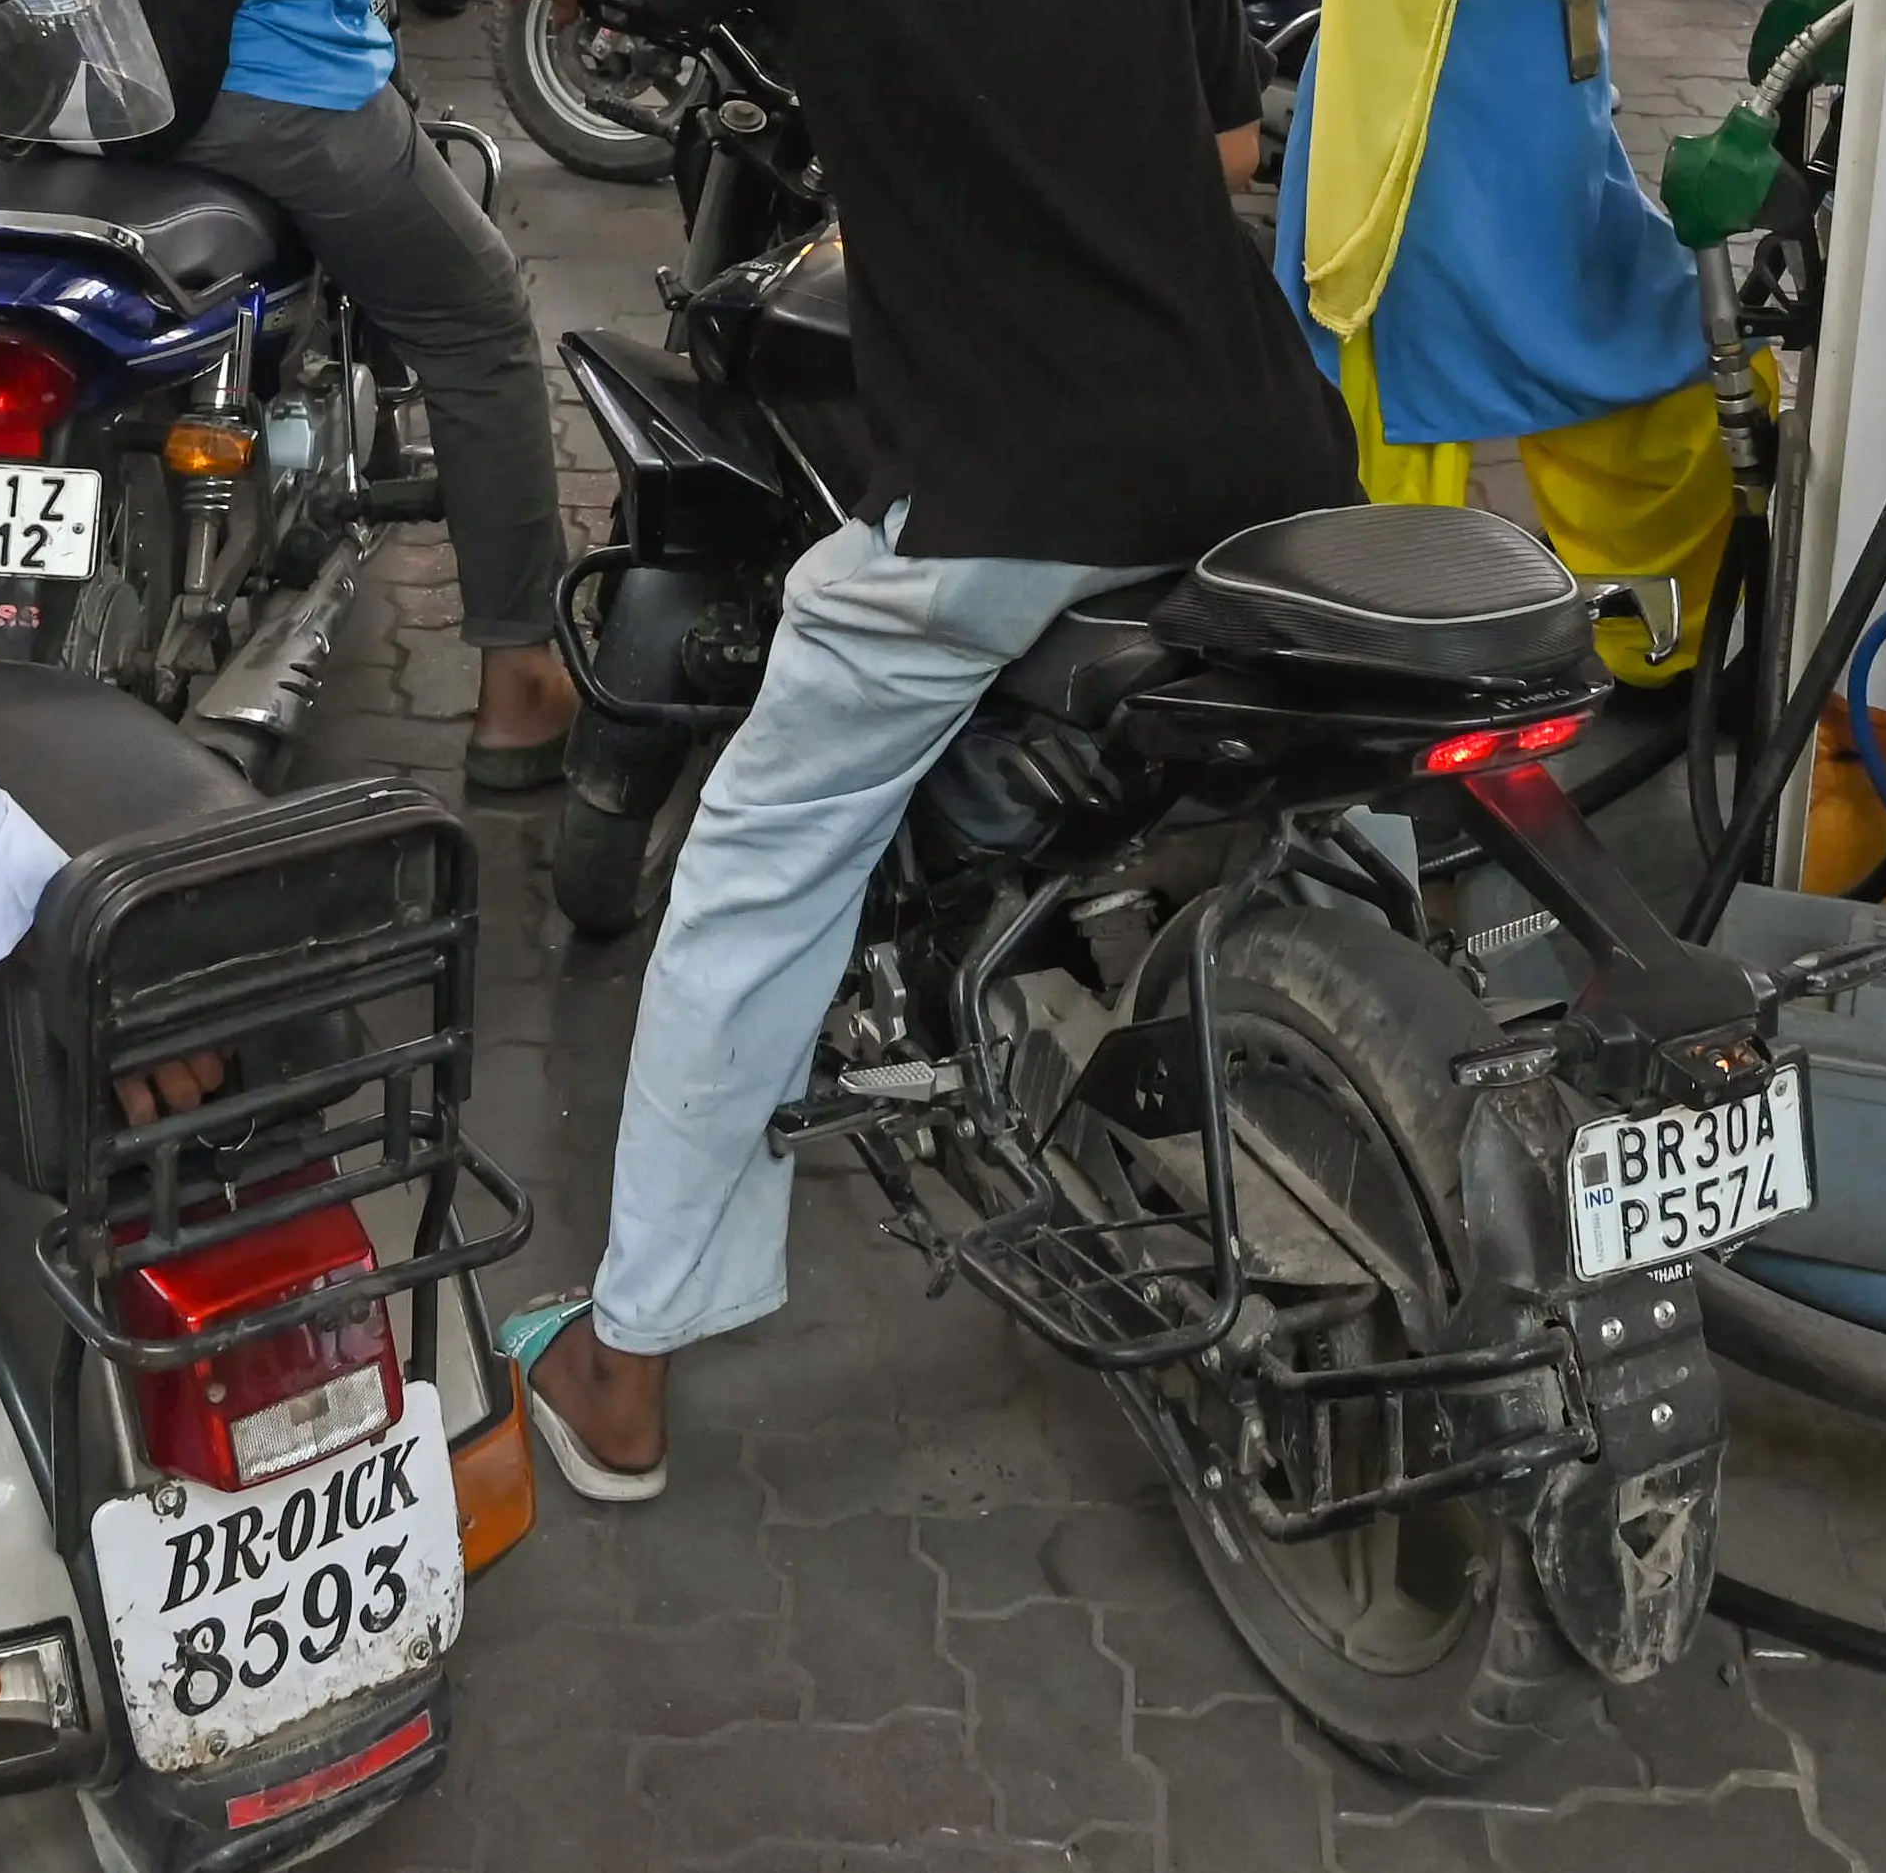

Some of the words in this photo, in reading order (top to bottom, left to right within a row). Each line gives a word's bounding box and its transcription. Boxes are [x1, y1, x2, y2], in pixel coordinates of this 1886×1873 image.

[1617, 1089, 1775, 1187] BR30A
[1584, 1187, 1614, 1209] IND
[1621, 1153, 1779, 1259] P5574
[159, 1435, 420, 1614] BR-01CK
[171, 1534, 410, 1719] 8593
